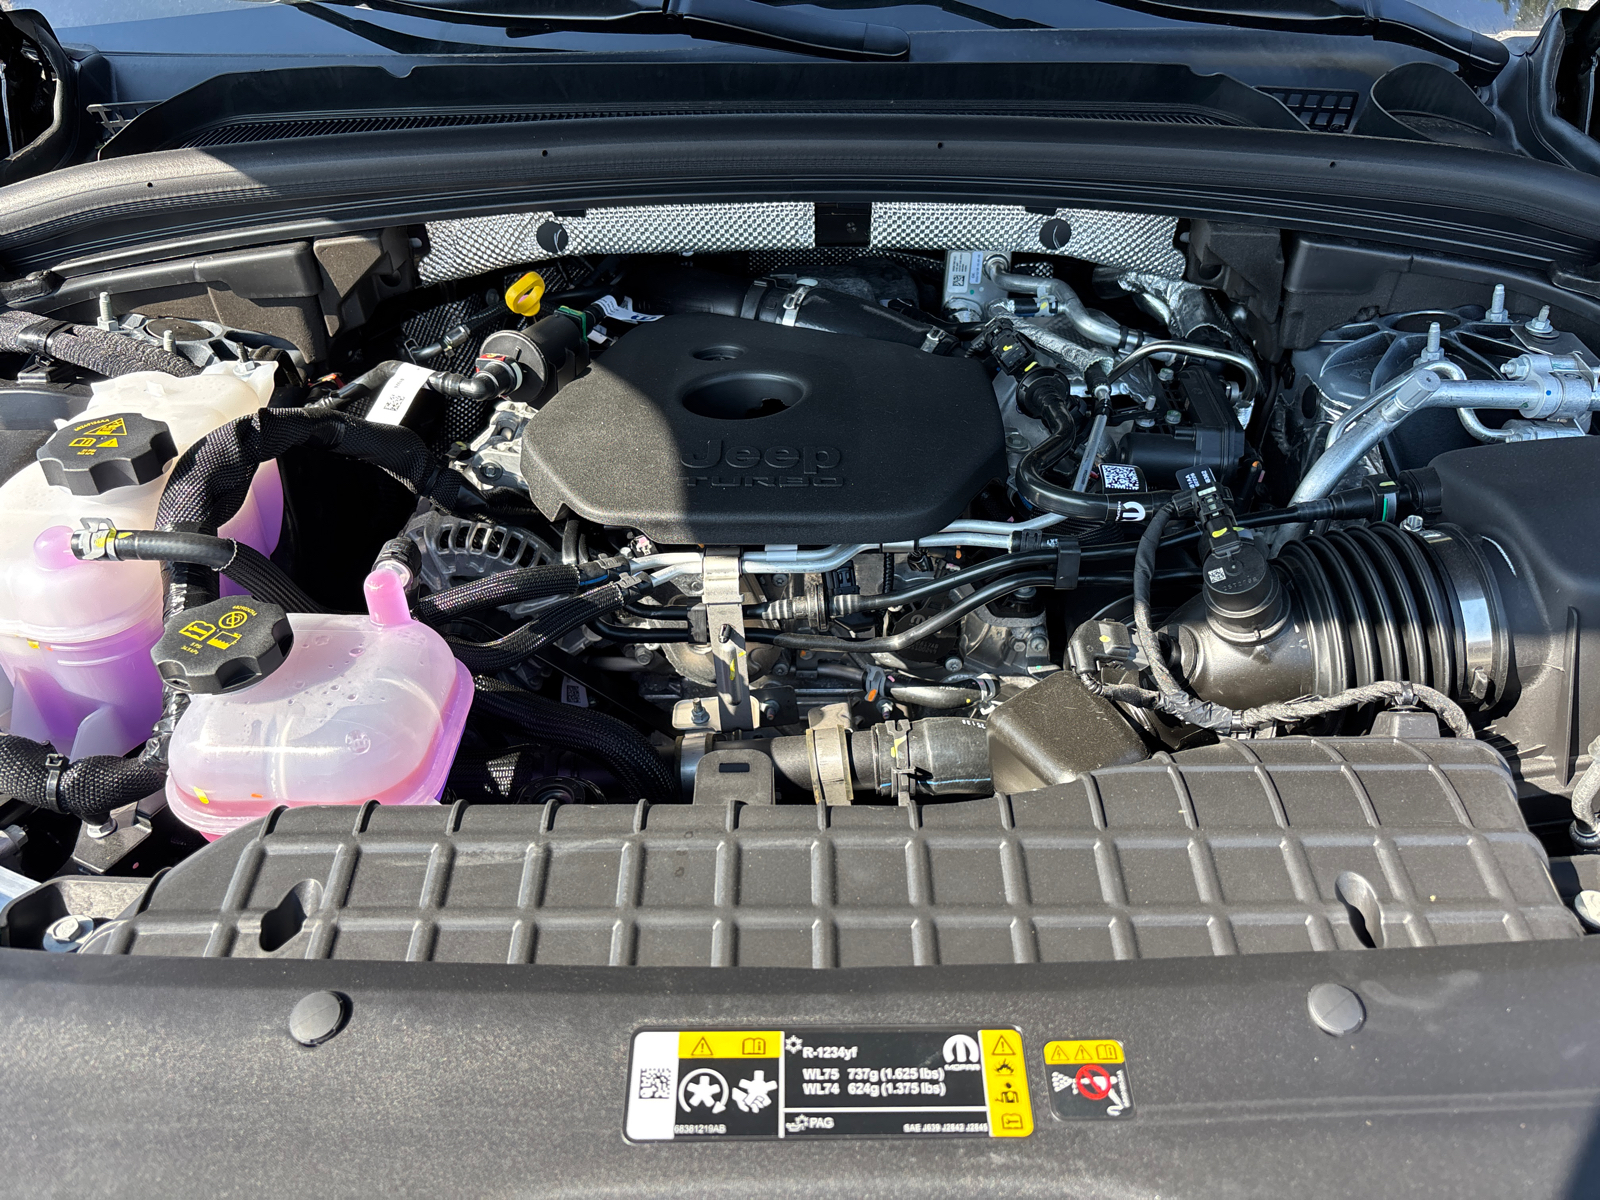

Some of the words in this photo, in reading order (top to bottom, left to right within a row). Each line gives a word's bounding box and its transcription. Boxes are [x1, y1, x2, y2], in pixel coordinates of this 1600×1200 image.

[680, 439, 841, 475] Jeep
[677, 475, 844, 487] TURBO
[802, 1046, 858, 1060] R-1234yf
[802, 1068, 840, 1080] WL75
[847, 1068, 879, 1082] 737g
[880, 1067, 919, 1082] (1.625
[919, 1067, 945, 1082] lbs)
[802, 1083, 840, 1095] WL74
[847, 1083, 880, 1097] 624g
[880, 1082, 920, 1097] (1.375
[921, 1082, 947, 1097] lbs)
[809, 1117, 835, 1129] PAG
